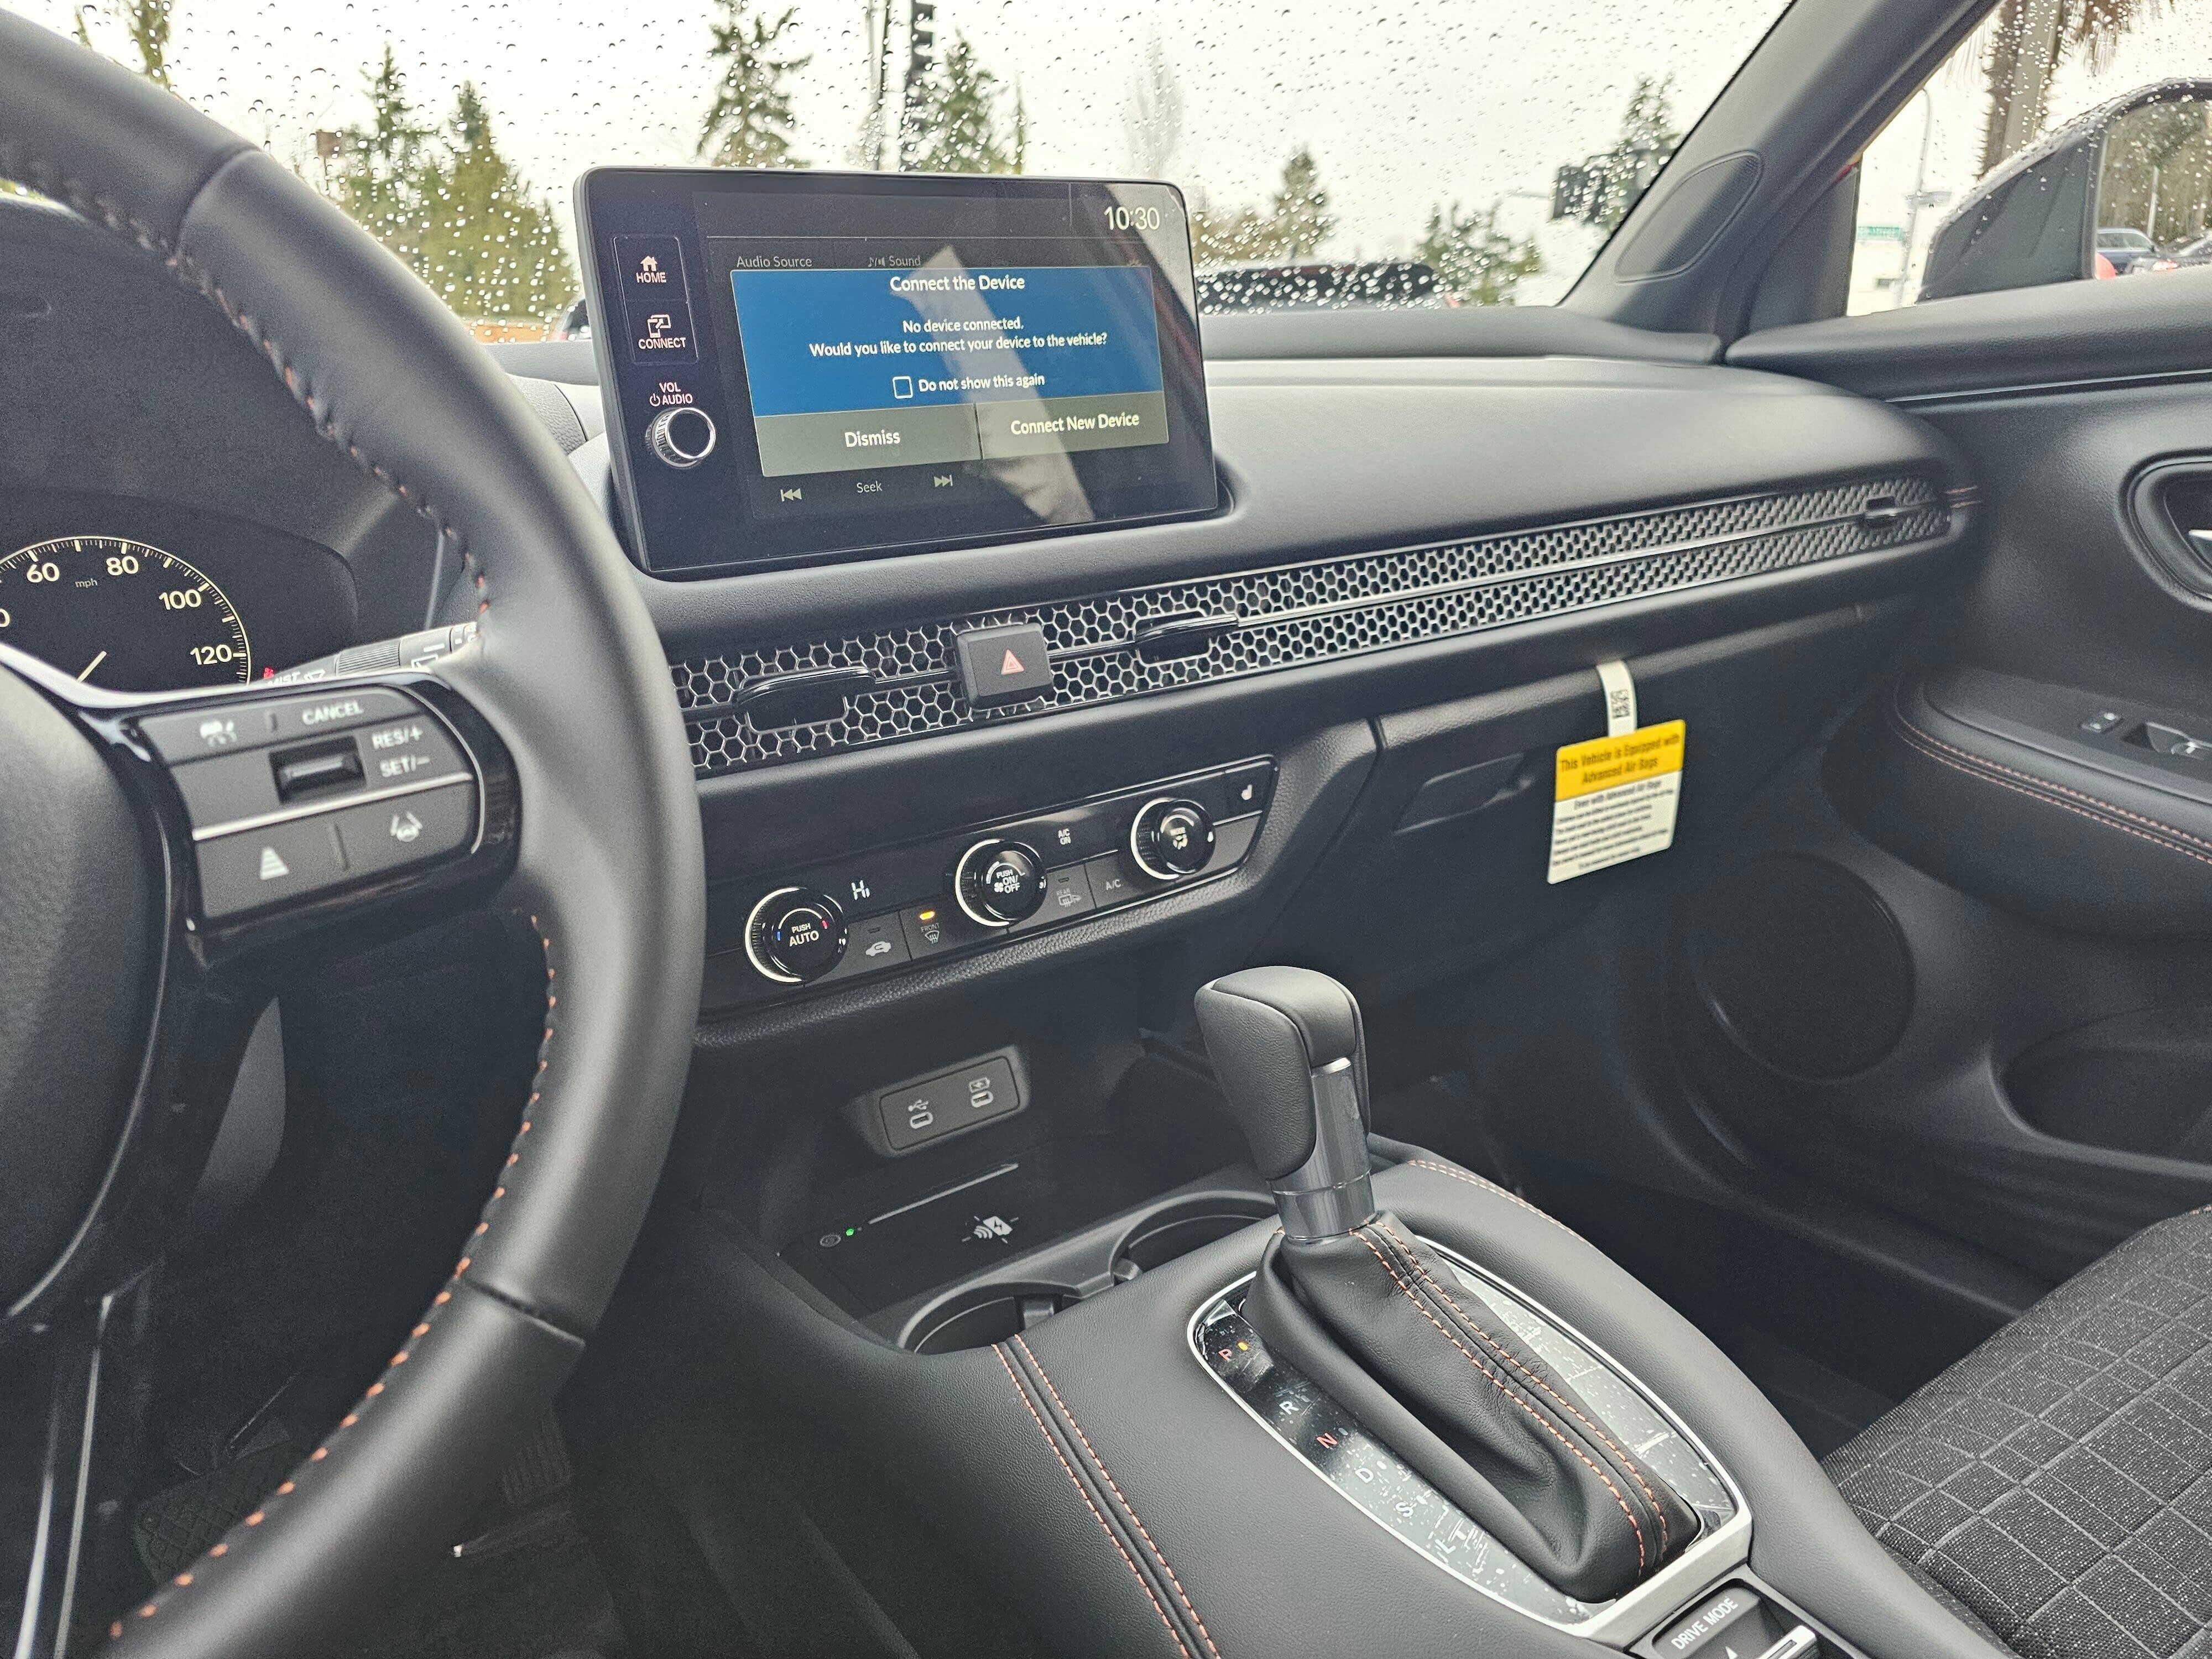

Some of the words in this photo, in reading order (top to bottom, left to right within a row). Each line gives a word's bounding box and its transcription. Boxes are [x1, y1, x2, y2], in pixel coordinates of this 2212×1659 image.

[1103, 206, 1160, 230] 10:30
[737, 256, 770, 268] Audio
[774, 256, 812, 267] Source
[889, 255, 921, 267] Sound
[636, 272, 666, 283] HOME
[890, 275, 950, 292] Connect
[953, 275, 976, 290] the
[979, 274, 1025, 290] Device
[902, 320, 921, 333] No
[924, 319, 961, 332] device
[963, 316, 1024, 331] connected.
[638, 337, 686, 349] CONNECT
[809, 342, 852, 357] Would
[854, 344, 878, 357] you
[880, 341, 901, 354] like
[903, 341, 916, 353] to
[919, 339, 965, 352] connect
[967, 340, 993, 352] your
[996, 336, 1031, 349] device
[1033, 336, 1045, 348] to
[1047, 333, 1065, 347] the
[1067, 332, 1107, 346] vehicle?
[659, 382, 681, 393] VOL
[919, 379, 936, 392] Do
[939, 378, 958, 391] not
[961, 377, 990, 389] show
[993, 374, 1014, 388] this
[1016, 373, 1045, 388] again
[662, 393, 693, 405] AUDIO
[1011, 418, 1065, 435] Connect
[1067, 415, 1095, 430] New
[1098, 412, 1139, 429] Device
[845, 429, 900, 447] Dismiss
[857, 482, 882, 494] Seek
[26, 562, 60, 583] 60
[106, 556, 139, 576] 80
[75, 578, 98, 588] mph
[158, 589, 202, 610] 100
[190, 644, 232, 665] 120
[302, 700, 364, 726] CANCEL
[372, 726, 423, 750] RES/+
[1561, 758, 1578, 773] This
[1581, 750, 1612, 766] Vehicle
[1625, 761, 1636, 773] Air
[1058, 828, 1070, 838] A/C
[1060, 836, 1071, 846] ON
[997, 869, 1013, 878] PUSH
[1003, 875, 1018, 886] ON/
[1004, 883, 1021, 894] OFF
[1106, 879, 1121, 890] A/C
[791, 922, 811, 934] PUSH
[921, 922, 940, 933] FRONT
[789, 930, 820, 947] AUTO
[1218, 1348, 1233, 1363] P
[1279, 1400, 1299, 1415] R
[1316, 1432, 1338, 1448] N
[1355, 1467, 1374, 1483] D
[1395, 1502, 1414, 1517] S
[1671, 1621, 1708, 1650] DRIVE
[1703, 1598, 1739, 1626] MODE
